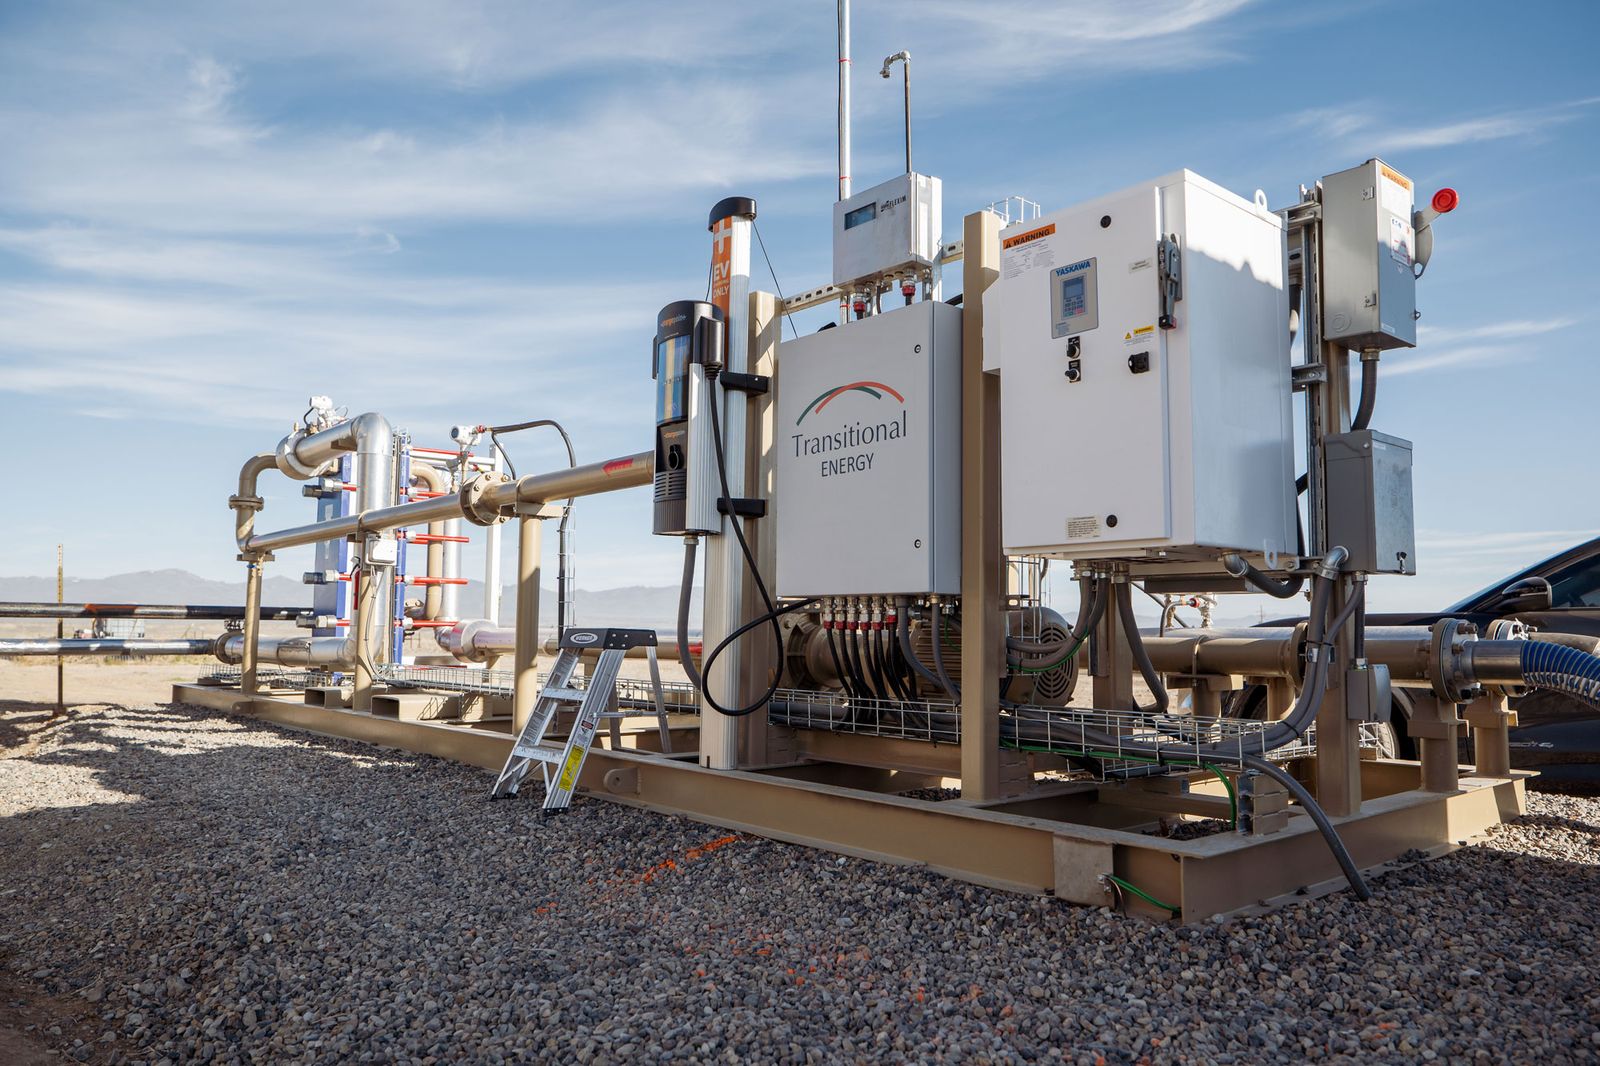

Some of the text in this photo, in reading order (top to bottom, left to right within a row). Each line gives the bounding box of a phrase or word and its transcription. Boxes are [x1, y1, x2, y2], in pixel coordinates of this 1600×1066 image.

[1013, 229, 1050, 246] WARNING
[713, 260, 730, 282] EV
[1056, 261, 1091, 277] YASKAWA
[713, 285, 730, 298] ONLY
[792, 410, 906, 457] Transitional
[822, 453, 874, 477] ENERGY
